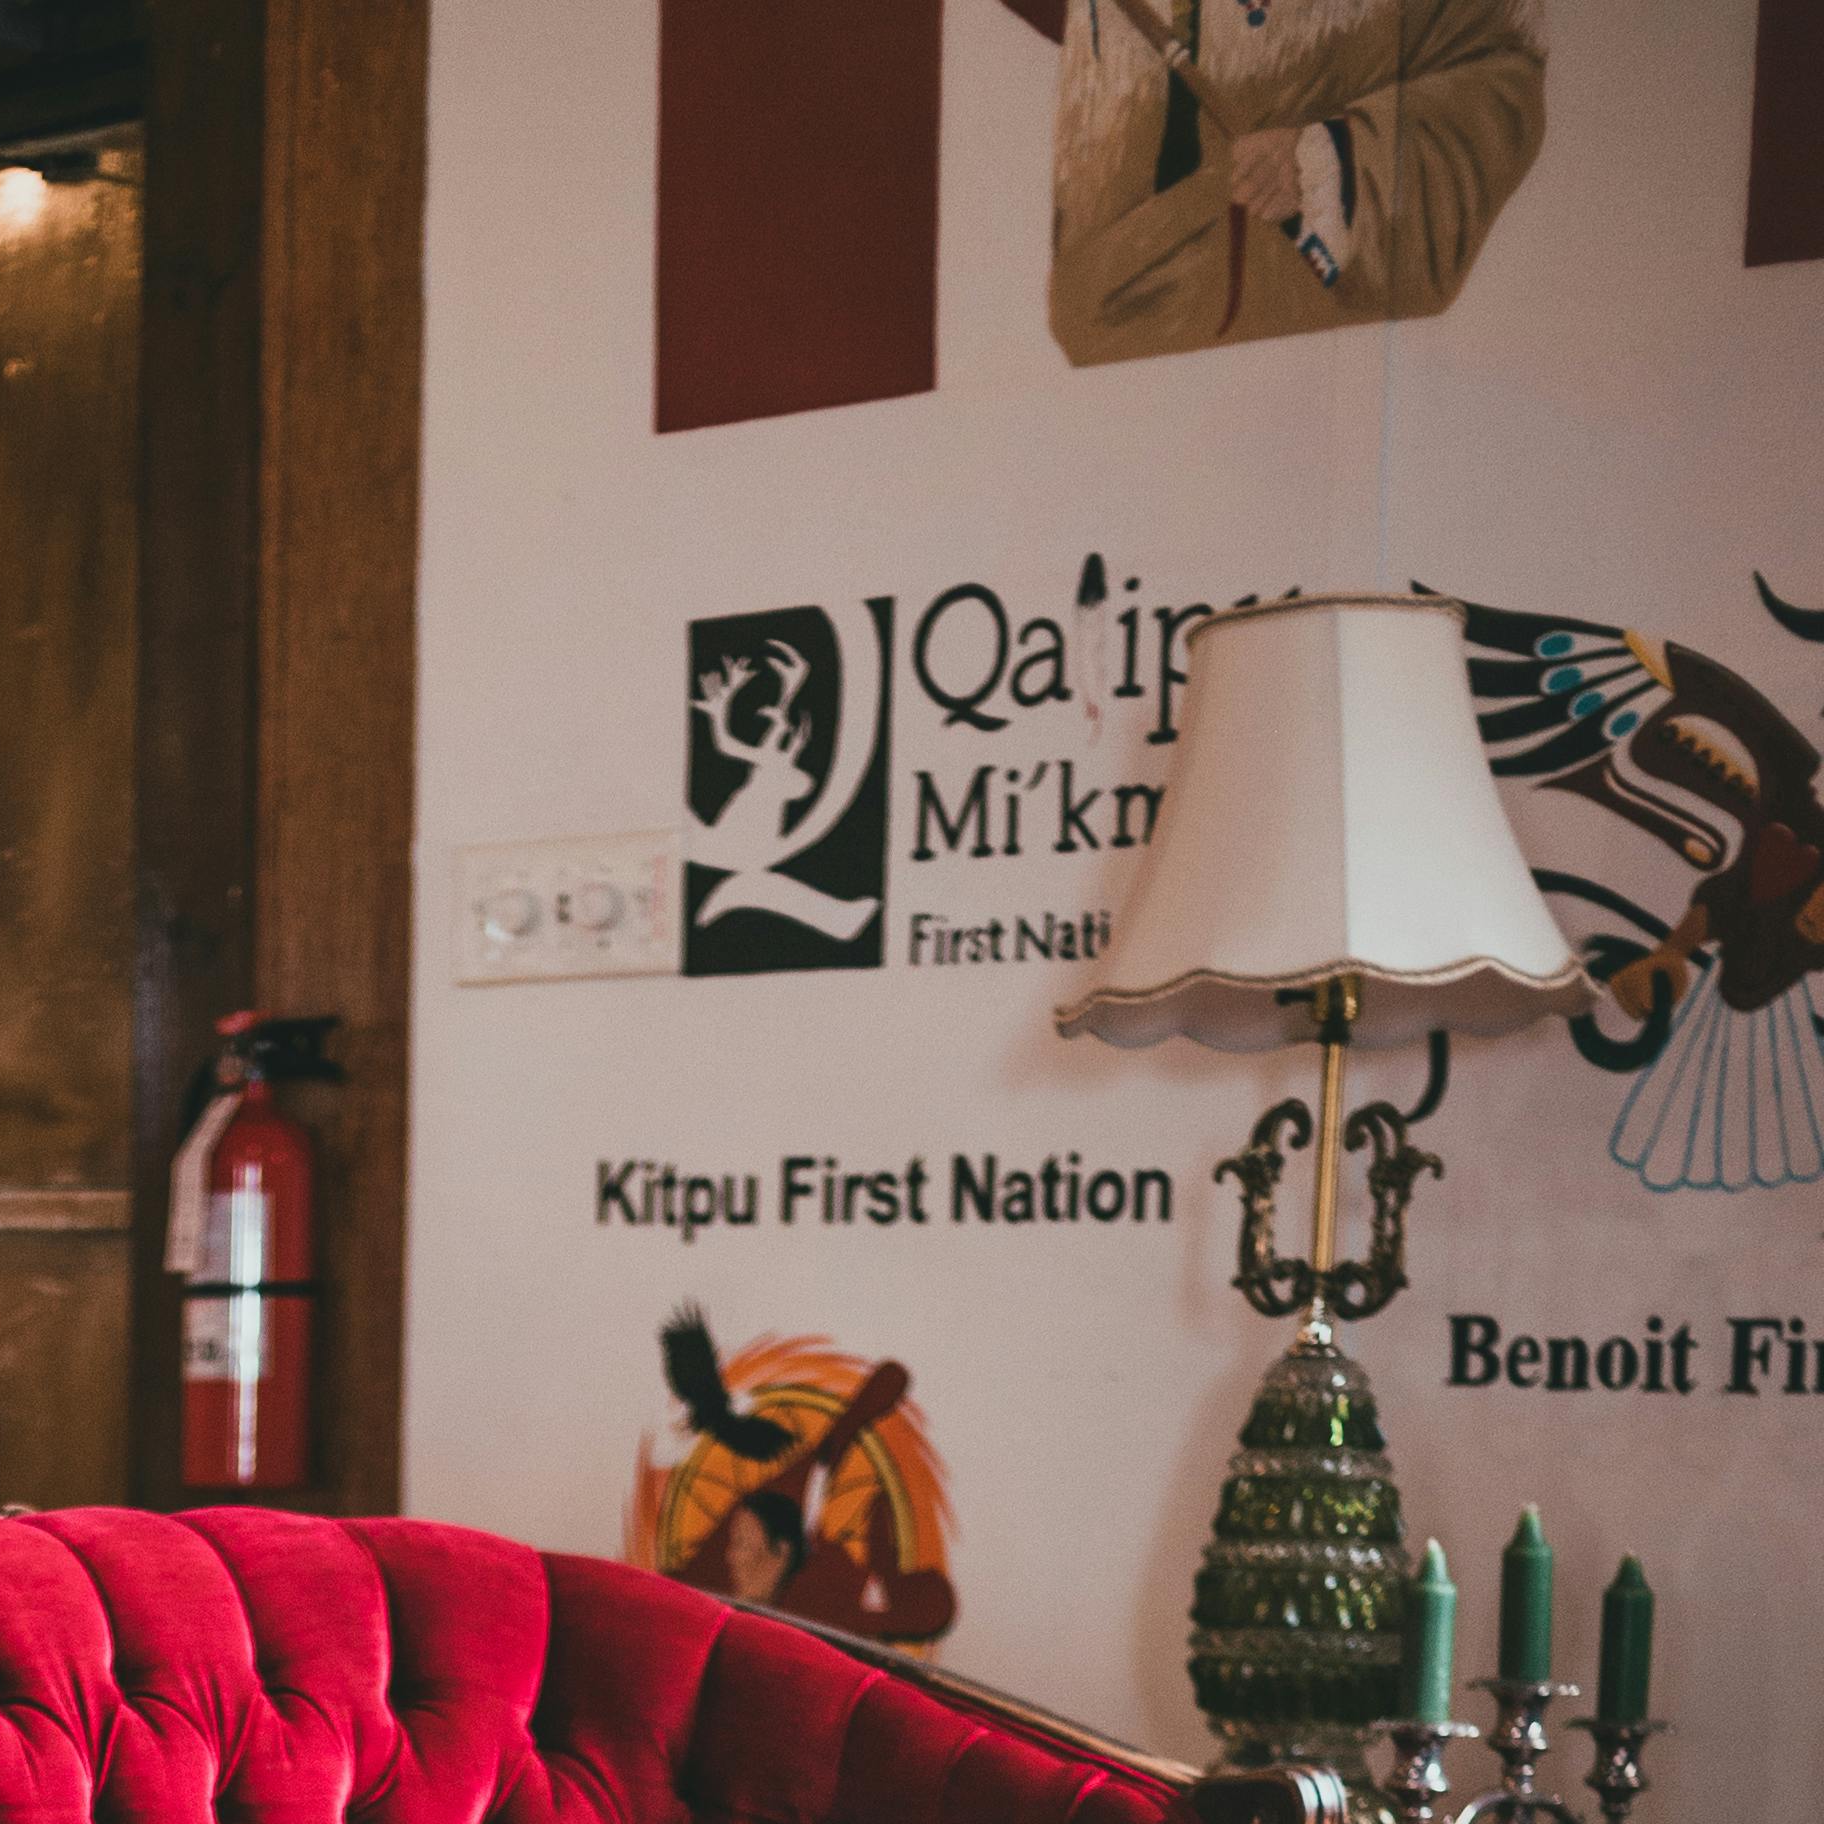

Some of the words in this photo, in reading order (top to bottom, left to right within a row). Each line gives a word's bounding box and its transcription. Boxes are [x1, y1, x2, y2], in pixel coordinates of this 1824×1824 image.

[909, 912, 1005, 967] First
[1012, 909, 1112, 963] Nati
[595, 1156, 759, 1245] Kitpu
[779, 1155, 929, 1226] First
[950, 1151, 1174, 1225] Nation
[1444, 1312, 1698, 1396] Benoit
